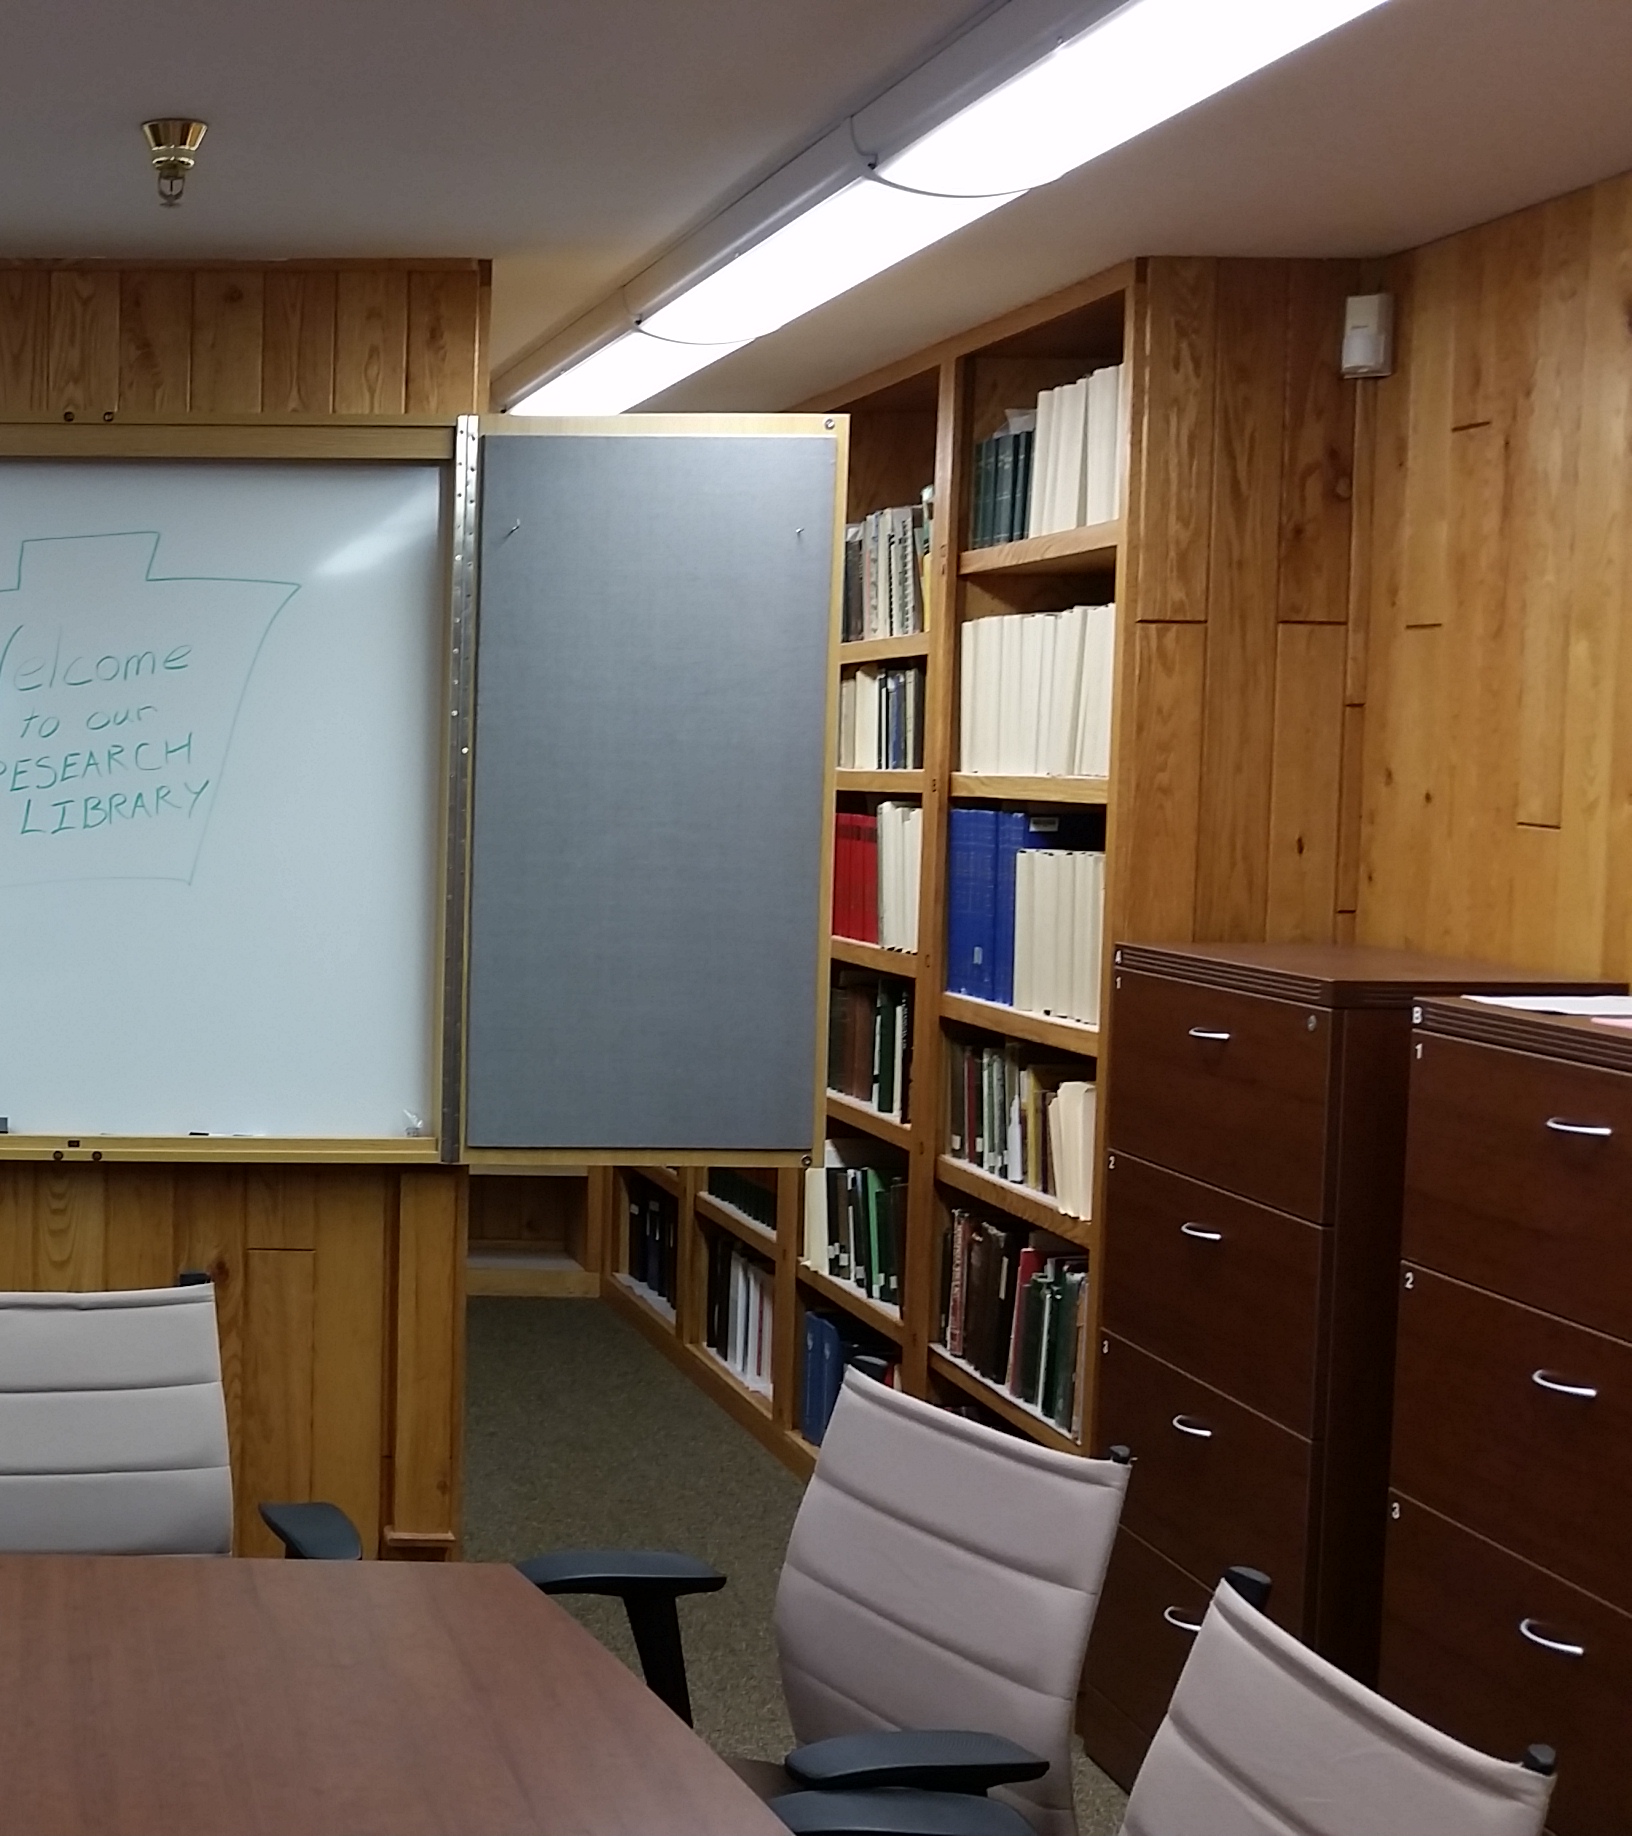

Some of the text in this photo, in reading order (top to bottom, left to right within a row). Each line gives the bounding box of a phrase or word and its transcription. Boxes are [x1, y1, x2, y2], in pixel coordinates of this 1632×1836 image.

[19, 705, 158, 738] to our
[20, 779, 209, 834] LIBRARY
[1116, 976, 1121, 989] 1
[1415, 1043, 1423, 1059] 1
[1108, 1155, 1116, 1169] 2
[1404, 1271, 1414, 1289] 2
[1102, 1339, 1109, 1354] 3
[1391, 1502, 1400, 1519] 3
